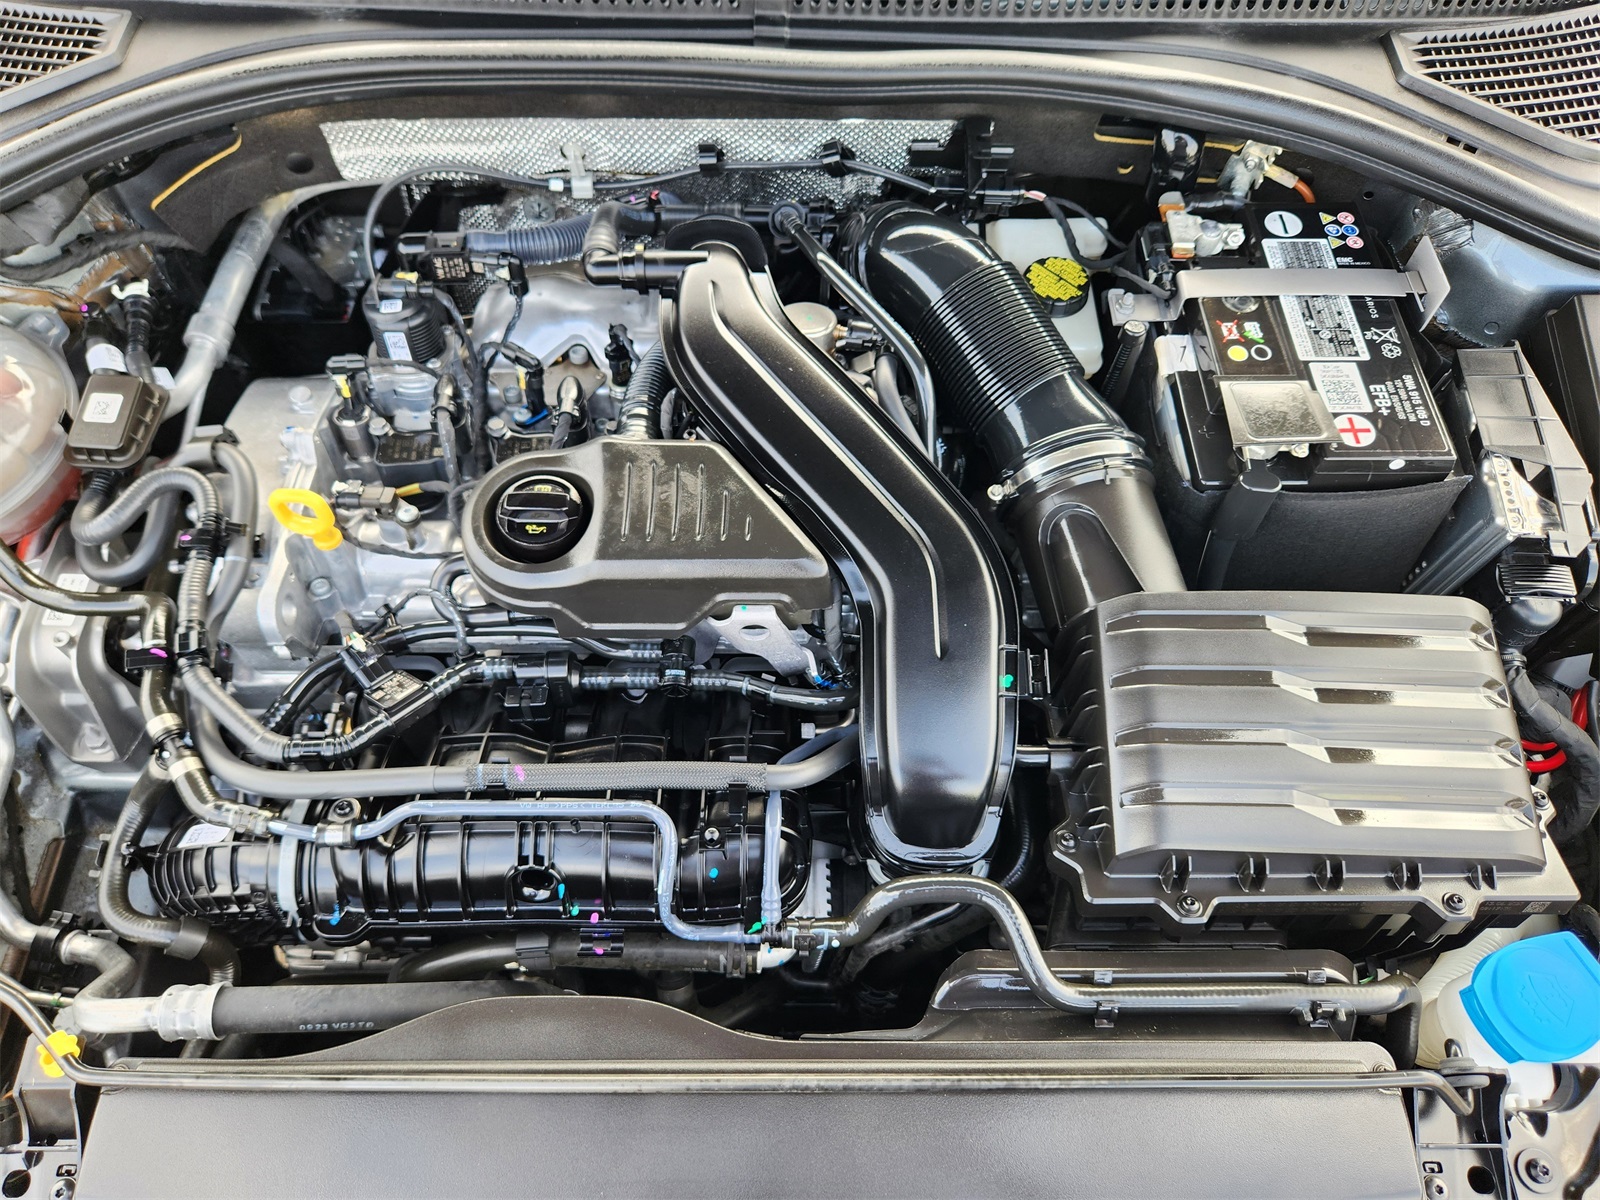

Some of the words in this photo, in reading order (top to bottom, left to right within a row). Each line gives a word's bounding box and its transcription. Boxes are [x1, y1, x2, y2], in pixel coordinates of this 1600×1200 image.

[1402, 374, 1417, 390] 5WA
[1368, 384, 1393, 416] EFB+
[1408, 390, 1422, 405] 915
[1414, 406, 1428, 419] 105
